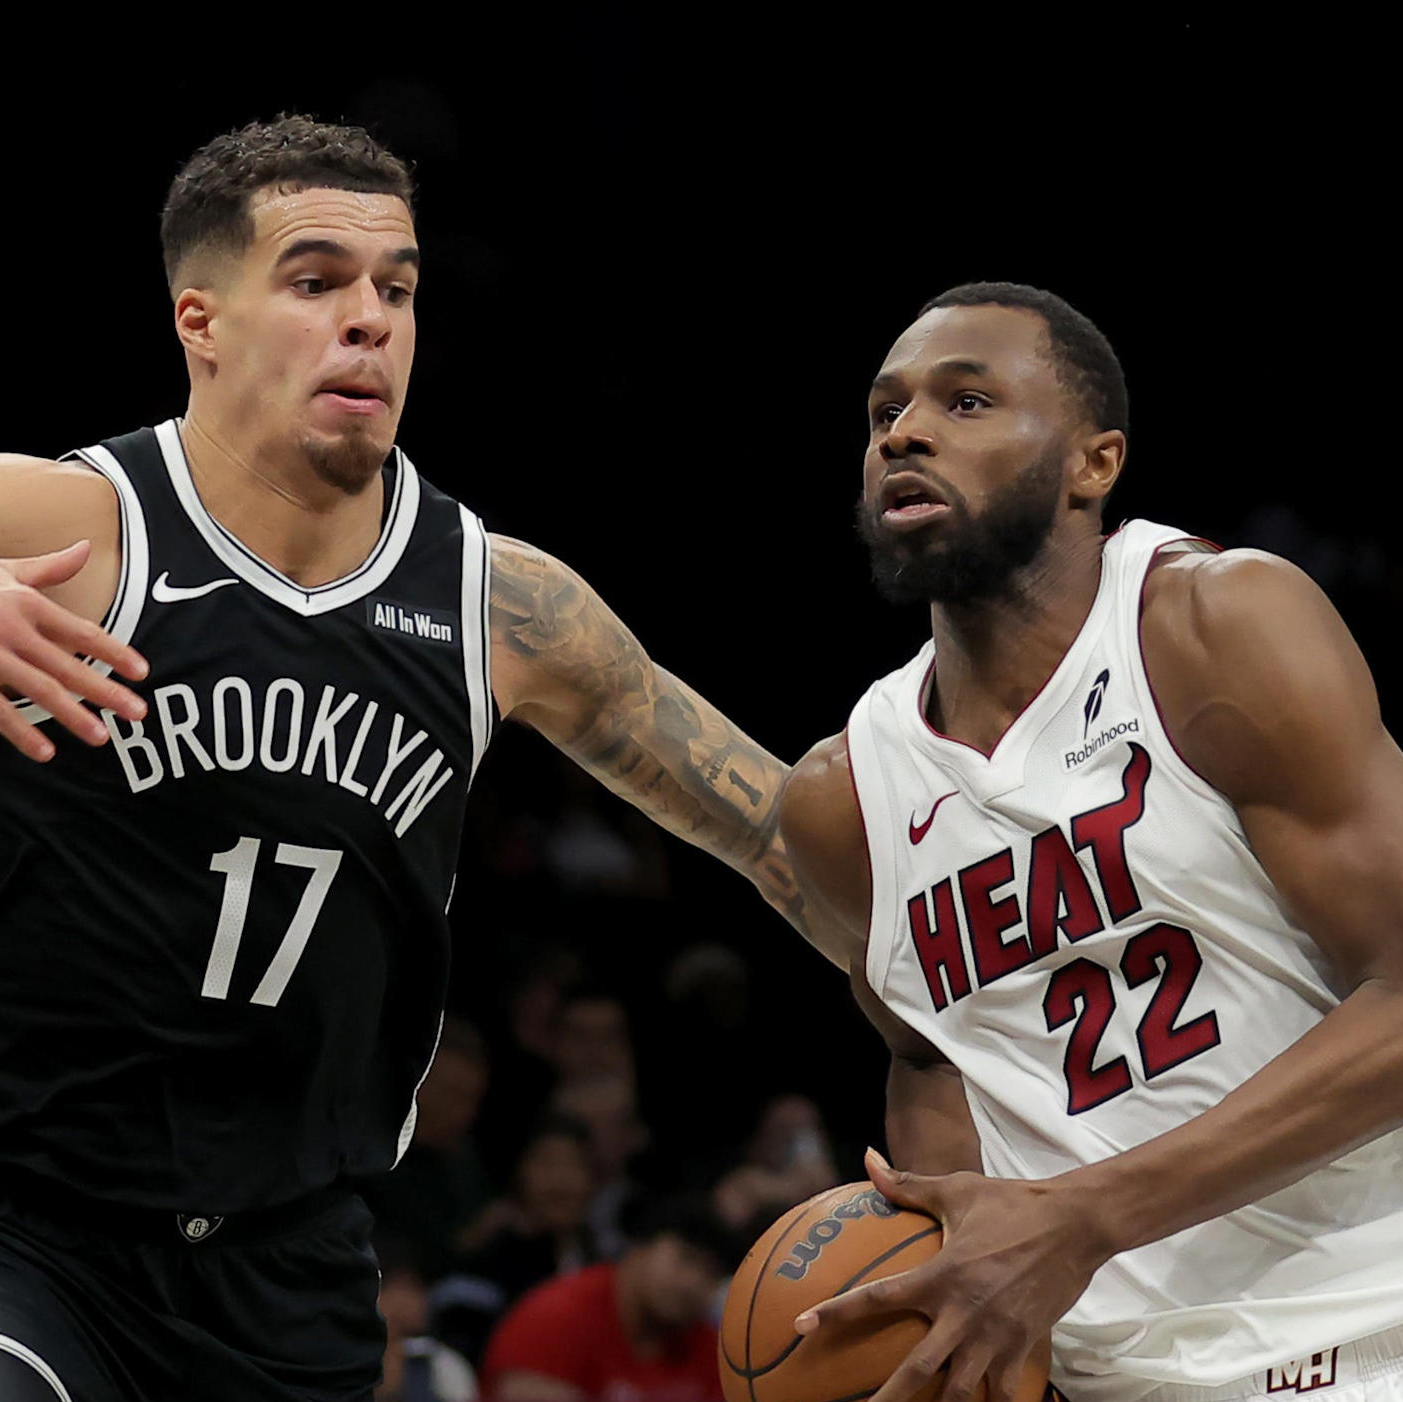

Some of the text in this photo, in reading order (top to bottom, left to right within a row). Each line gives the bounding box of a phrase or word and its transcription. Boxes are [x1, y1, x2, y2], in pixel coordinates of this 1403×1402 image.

[374, 603, 452, 642] All In Won
[100, 676, 453, 838] BROOKLYN
[1065, 718, 1139, 769] Robinhood
[201, 835, 344, 1007] 17
[907, 741, 1152, 1013] HEAT
[1042, 922, 1222, 1116] 22
